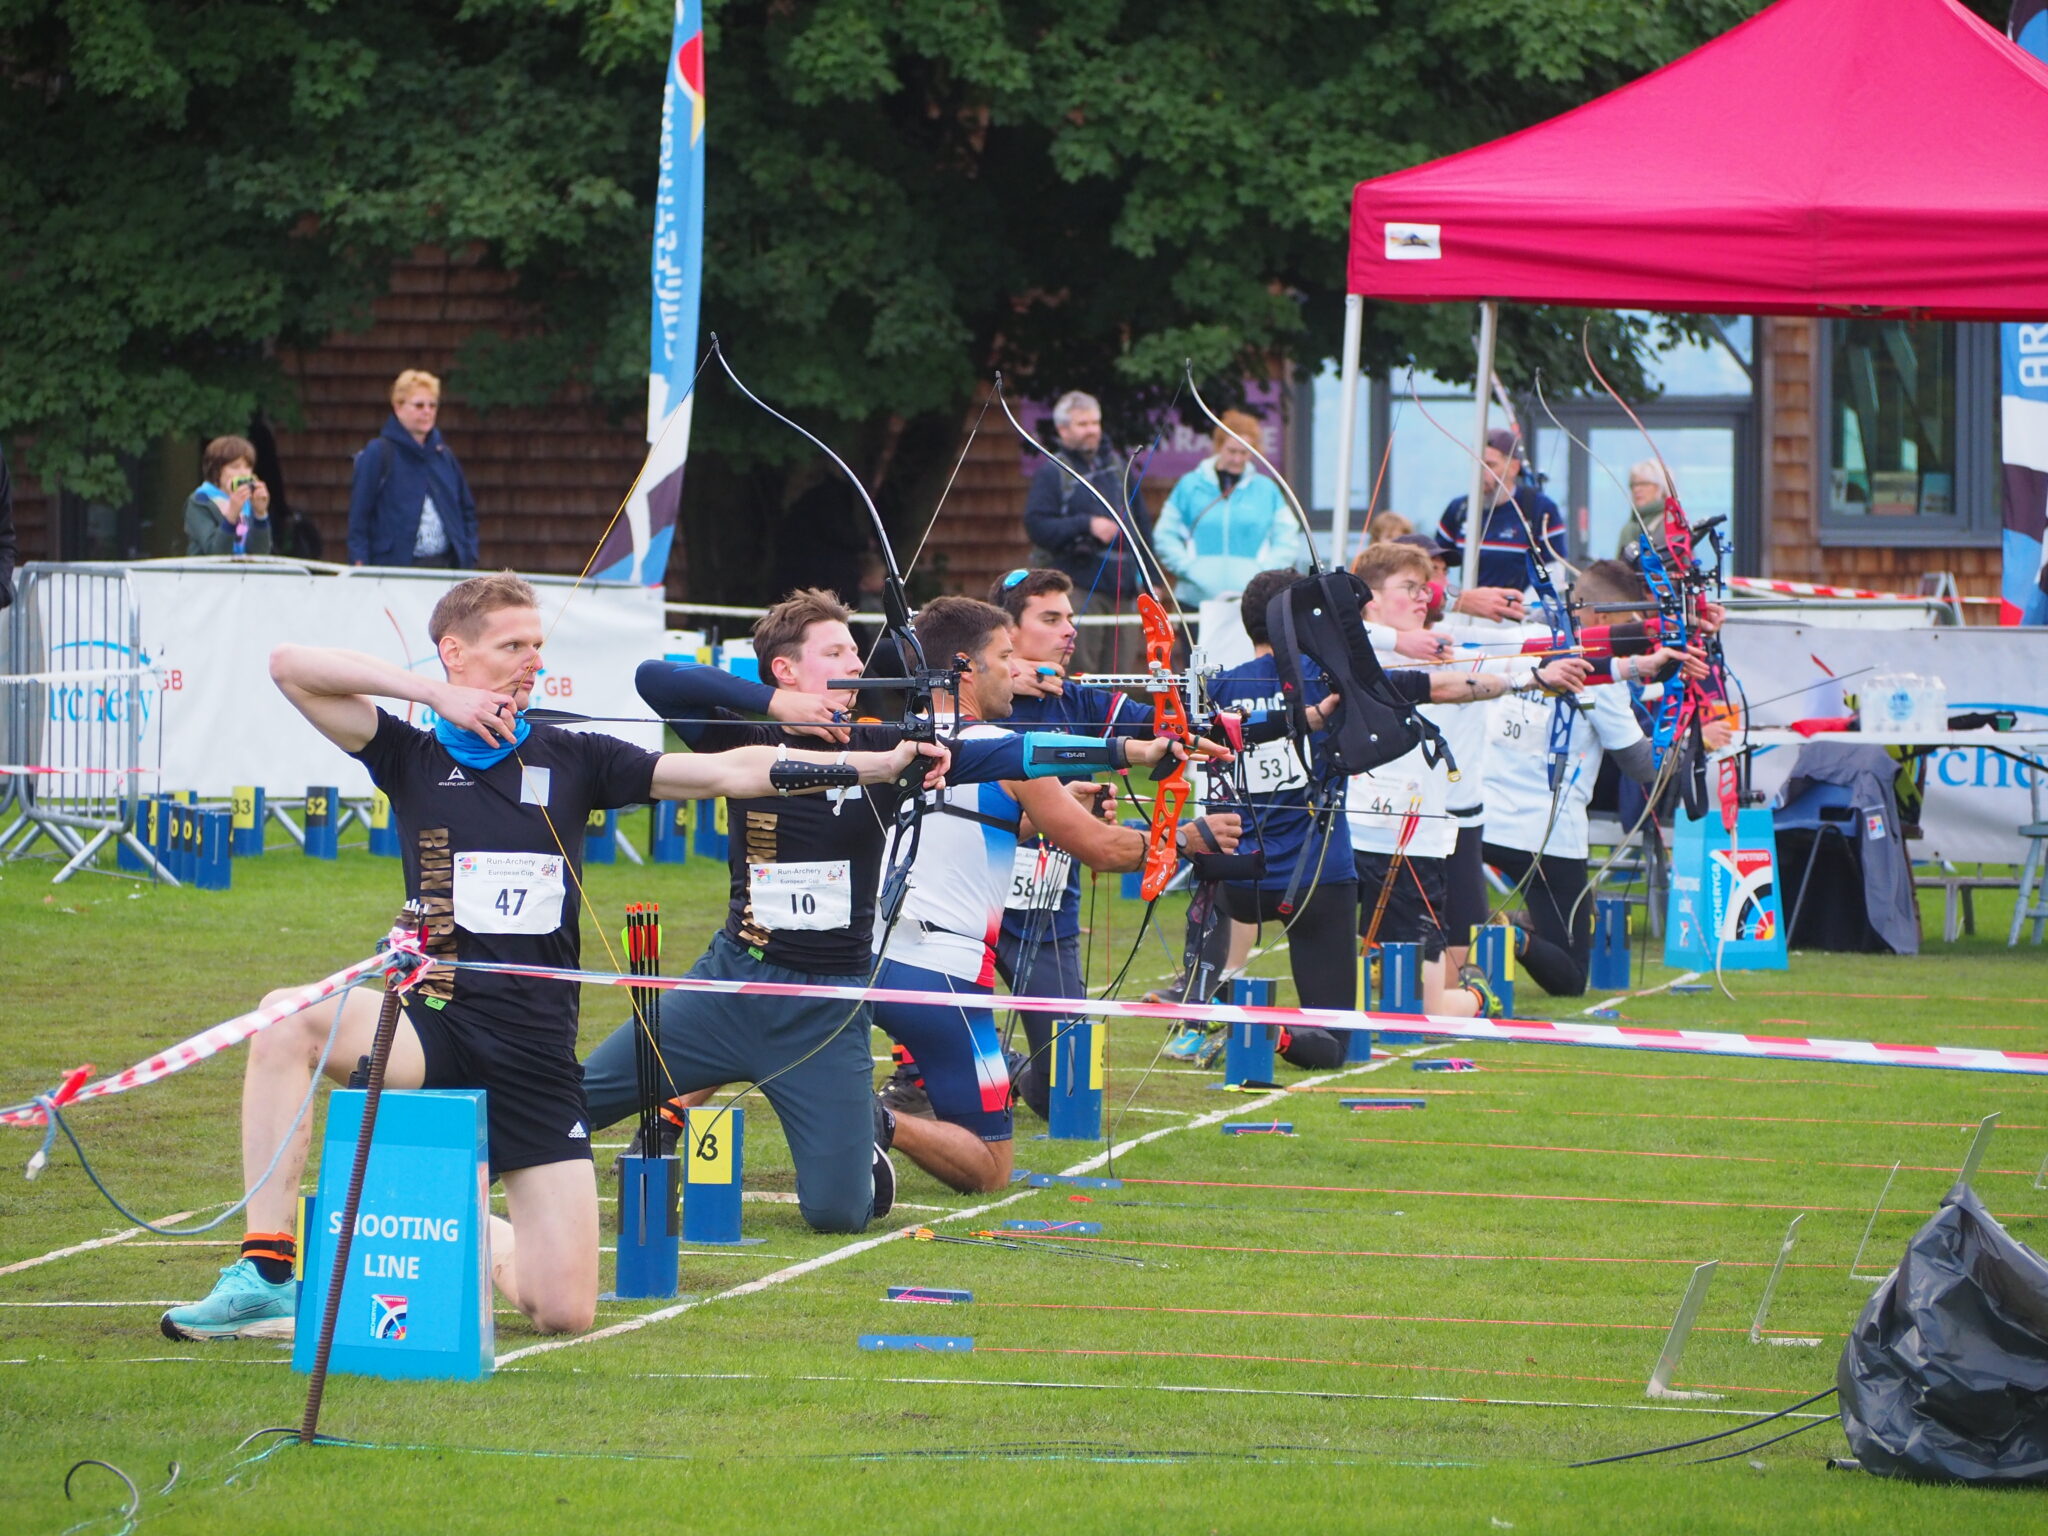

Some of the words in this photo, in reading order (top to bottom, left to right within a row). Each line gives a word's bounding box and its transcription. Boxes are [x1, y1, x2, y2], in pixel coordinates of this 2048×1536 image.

[544, 676, 573, 697] GB
[1503, 720, 1521, 740] 30
[1259, 758, 1282, 780] 53
[306, 797, 327, 816] 52
[1371, 797, 1393, 815] 46
[419, 828, 452, 890] RUN
[486, 857, 536, 867] Run-Archery
[1012, 876, 1035, 898] 58
[495, 888, 528, 916] 47
[791, 893, 816, 915] 10
[364, 1254, 420, 1280] LINE
